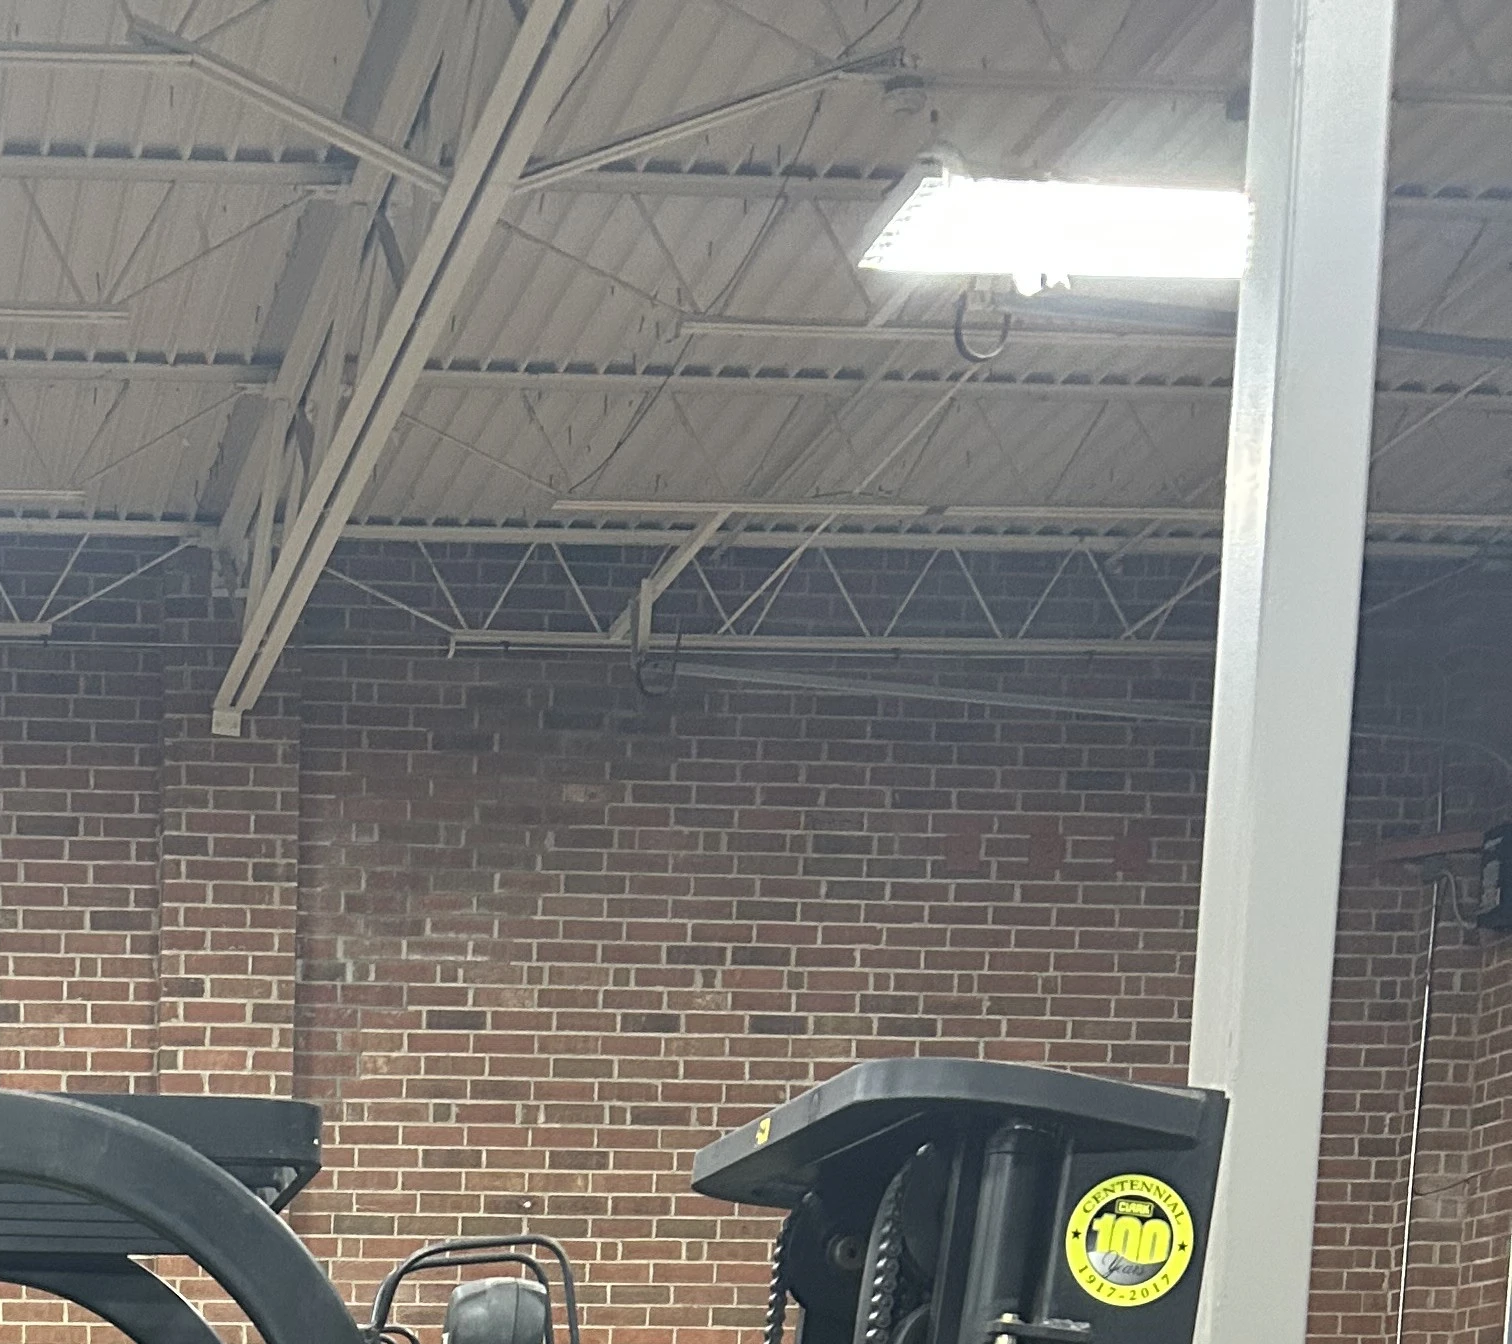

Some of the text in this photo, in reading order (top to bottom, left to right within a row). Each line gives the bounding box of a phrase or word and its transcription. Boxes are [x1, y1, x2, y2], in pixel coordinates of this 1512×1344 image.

[1082, 1179, 1185, 1225] CENTENNIAL
[1092, 1212, 1171, 1265] 100
[1078, 1273, 1171, 1301] 1917-2017
